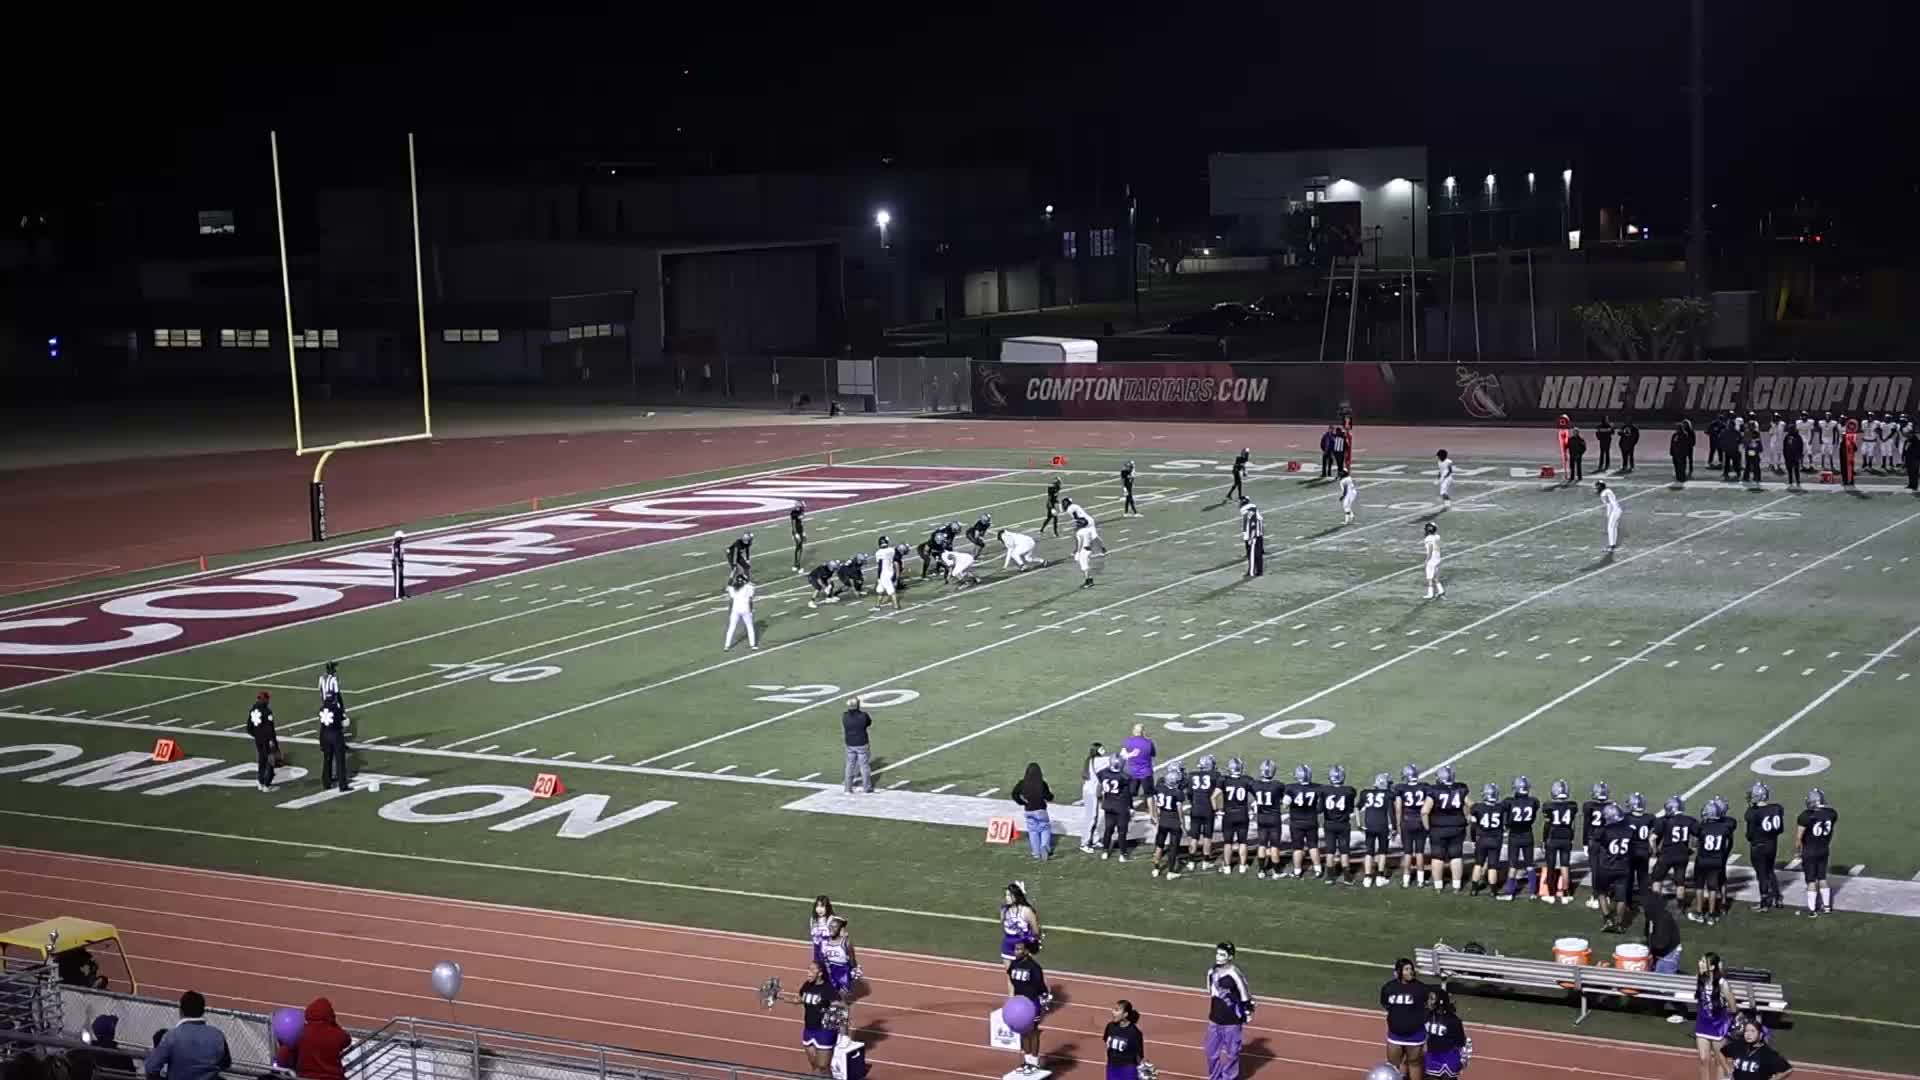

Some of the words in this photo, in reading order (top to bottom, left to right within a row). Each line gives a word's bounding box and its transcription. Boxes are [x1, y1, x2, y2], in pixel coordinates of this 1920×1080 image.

[1026, 377, 1269, 402] COMPTONTARTARS.COM
[1539, 376, 1630, 409] HOME
[1635, 376, 1677, 409] OF
[1685, 376, 1742, 410] THE
[1752, 376, 1913, 411] COMPTON
[0, 478, 910, 657] COMPTON
[752, 684, 921, 708] 20
[1164, 712, 1336, 740] 30
[155, 743, 171, 759] 10
[1638, 746, 1832, 777] 40
[534, 777, 553, 795] 20
[1101, 778, 1120, 794] 62
[1191, 774, 1212, 790] 33
[1156, 793, 1173, 810] 31
[1225, 786, 1246, 802] 70
[1255, 791, 1273, 806] 11
[1293, 791, 1316, 807] 47
[1364, 792, 1385, 808] 35
[1404, 791, 1424, 807] 32
[1438, 792, 1461, 809] 74
[1325, 795, 1345, 811] 64
[1479, 813, 1500, 828] 45
[1511, 806, 1533, 822] 22
[1551, 809, 1571, 825] 14
[990, 820, 1010, 841] 30
[1761, 815, 1780, 832] 60
[1812, 819, 1832, 837] 63
[1671, 826, 1689, 842] 51
[1704, 834, 1723, 851] 81
[1608, 838, 1630, 855] 65
